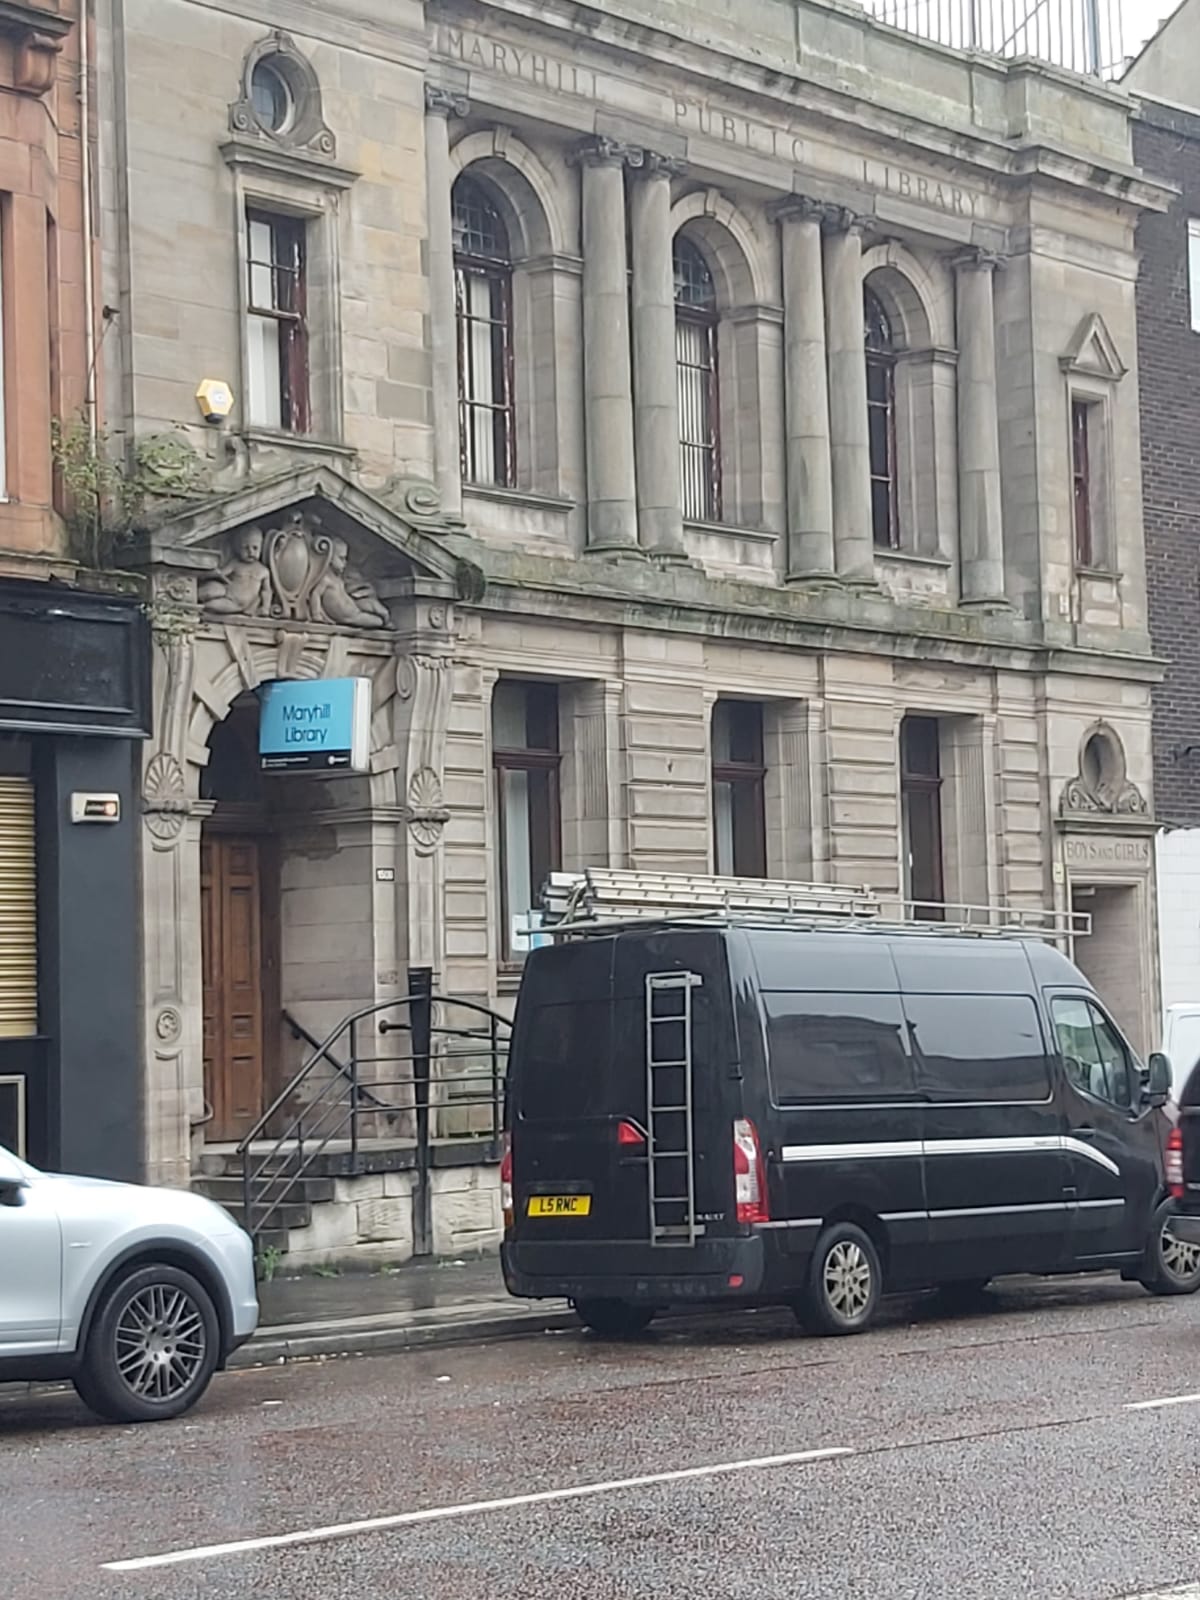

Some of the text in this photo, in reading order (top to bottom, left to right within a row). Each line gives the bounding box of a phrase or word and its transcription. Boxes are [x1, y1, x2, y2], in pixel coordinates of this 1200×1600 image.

[448, 32, 979, 216] MARYHILL PUBLIC LIBRARY
[283, 704, 331, 723] Maryhill
[285, 727, 328, 744] Library
[1066, 841, 1096, 859] BOYS
[1115, 843, 1149, 861] GIRLS
